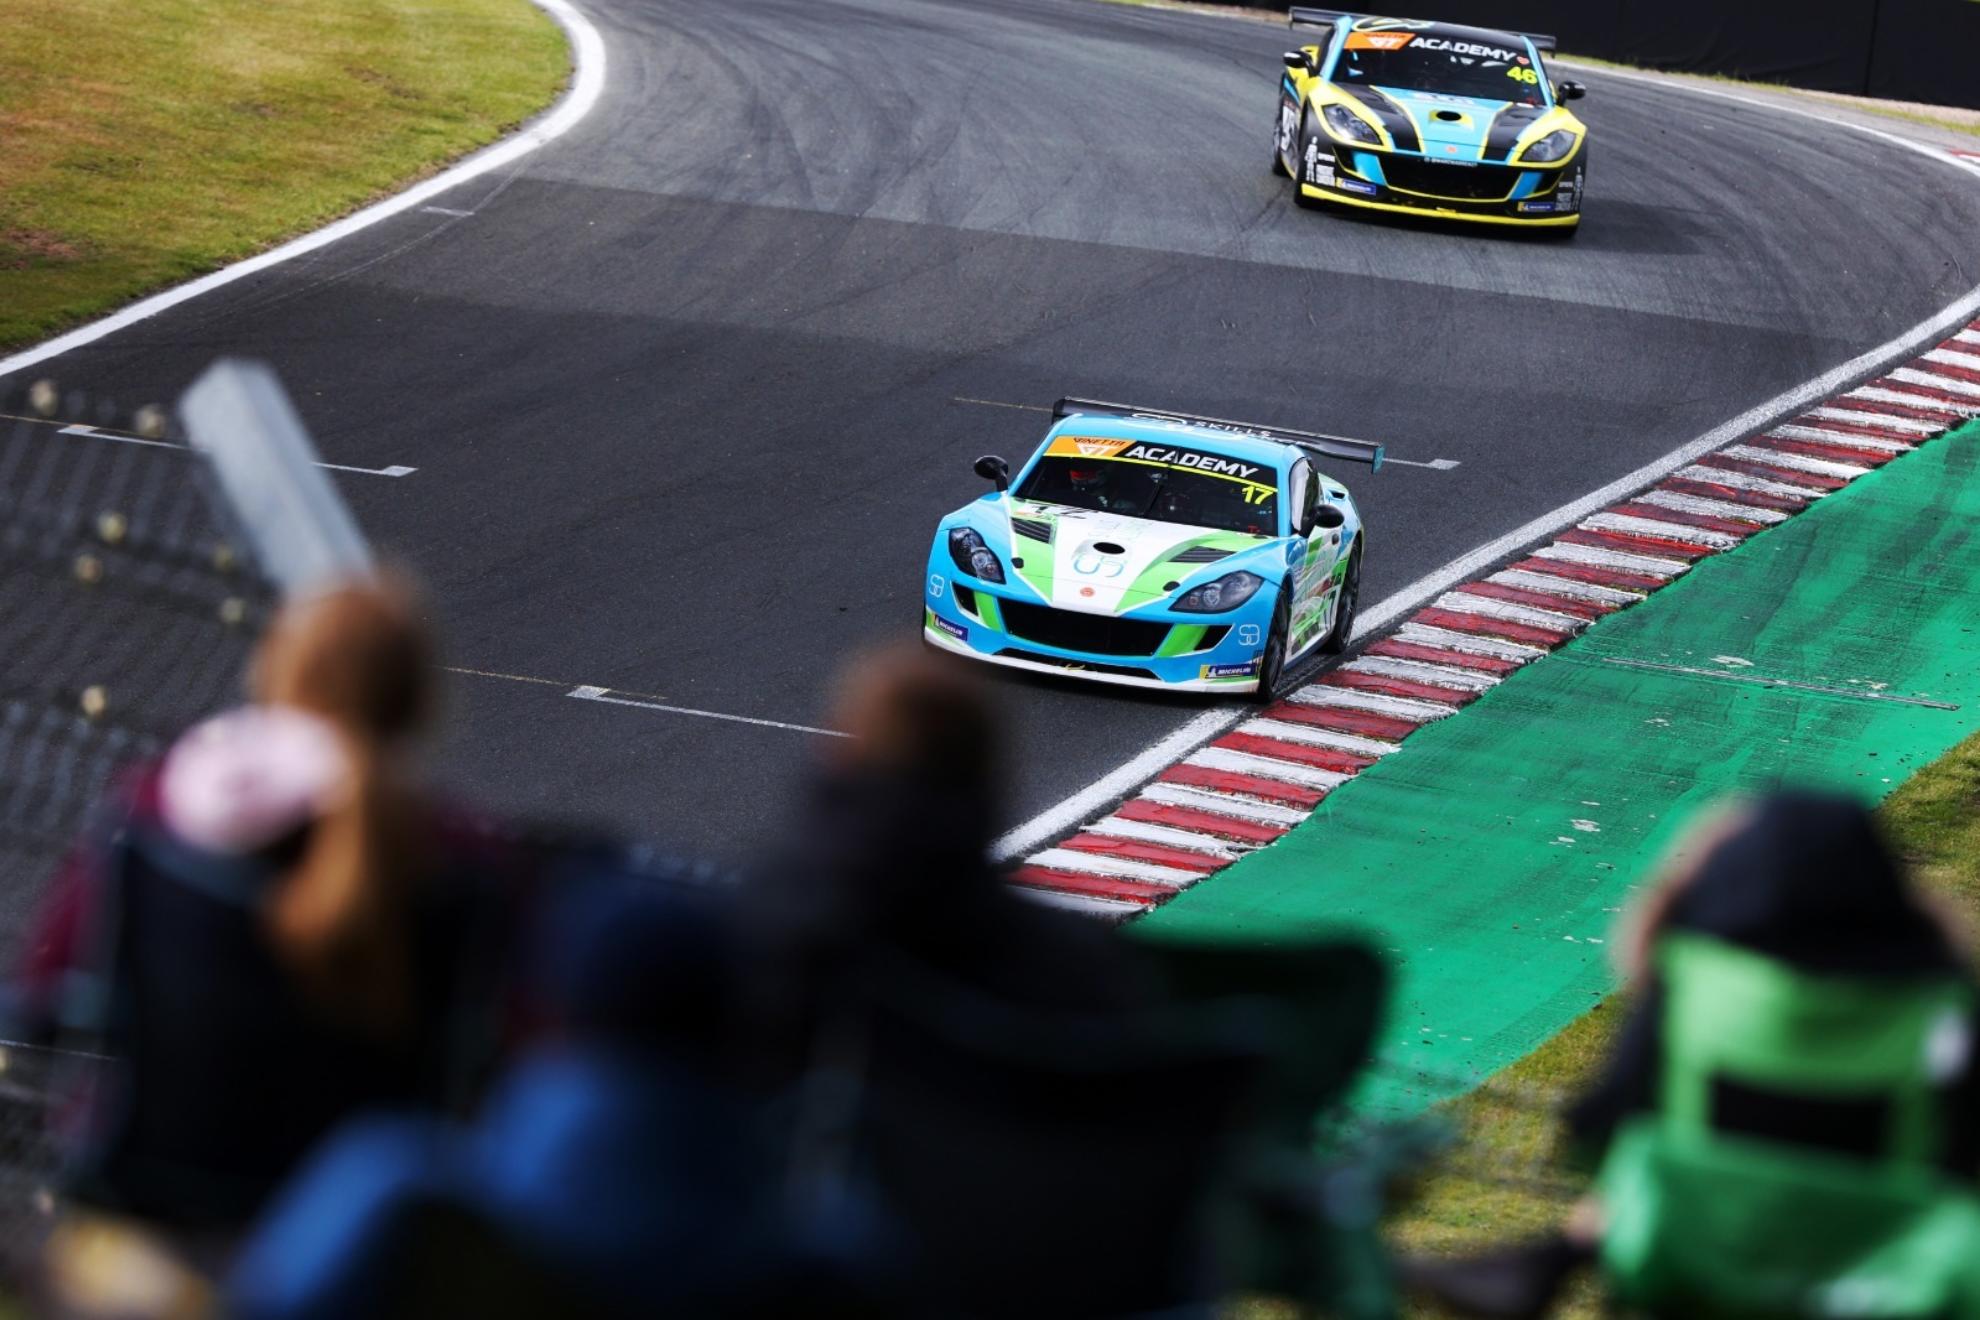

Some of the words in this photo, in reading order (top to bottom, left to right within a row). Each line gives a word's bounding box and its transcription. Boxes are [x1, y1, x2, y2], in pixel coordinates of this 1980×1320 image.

[1409, 37, 1518, 62] ACADEMY
[1506, 66, 1538, 85] 46
[1195, 420, 1271, 437] SKILLS
[1125, 445, 1259, 479] ACADEMY
[1241, 485, 1274, 505] 17
